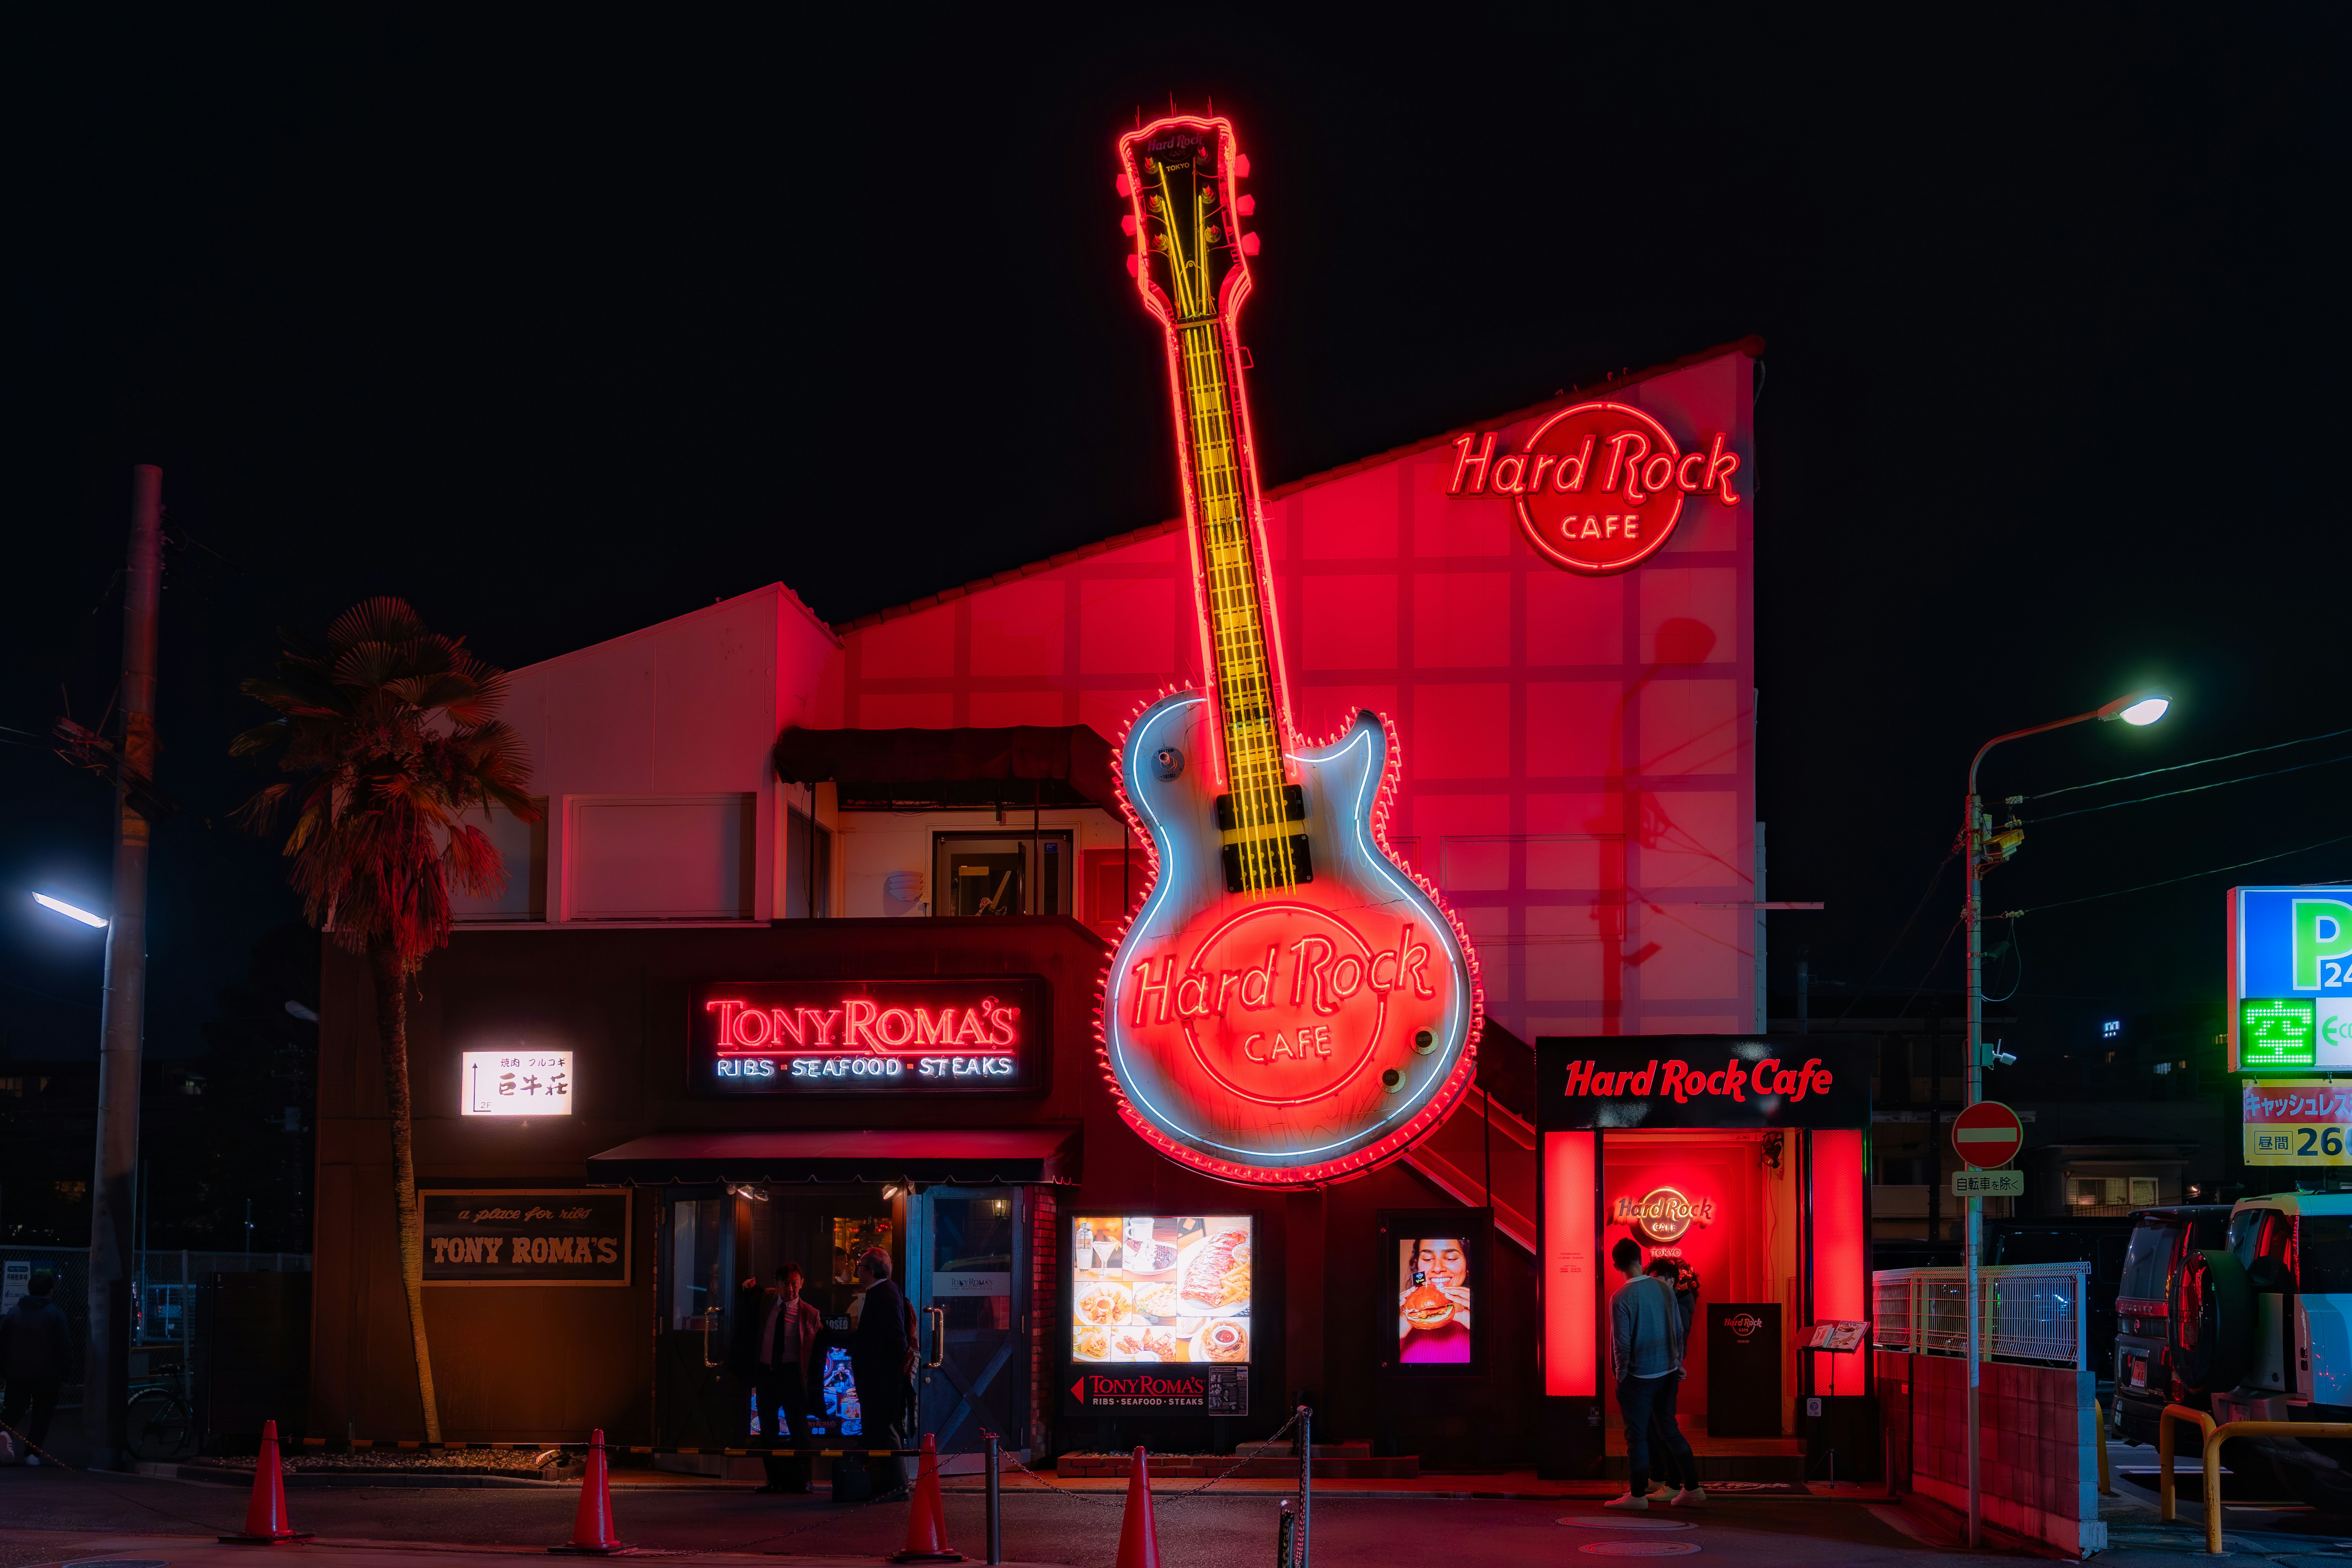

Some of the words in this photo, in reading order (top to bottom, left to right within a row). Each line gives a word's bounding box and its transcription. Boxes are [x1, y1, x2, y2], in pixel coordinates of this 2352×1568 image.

[1147, 136, 1175, 152] Hard
[1176, 133, 1204, 149] Rock
[1166, 162, 1190, 172] TOKYO
[1446, 431, 1597, 495] Hard
[1601, 430, 1740, 506] Rock
[1560, 514, 1640, 541] CAFE
[1131, 944, 1280, 1029] Hard
[1289, 922, 1436, 1016] Rock
[2246, 1001, 2312, 1064] 空
[1243, 1024, 1333, 1064] CAFE
[501, 1058, 520, 1067] 焼肉
[717, 1058, 775, 1077] RIBS
[791, 1058, 903, 1077] SEAFOOD
[919, 1057, 1013, 1078] STEAKS
[1564, 1060, 1658, 1096] Hard
[1660, 1059, 1748, 1104] Rock
[1751, 1058, 1833, 1102] Cafe
[2245, 1093, 2352, 1117] キャッシュレス
[2259, 1136, 2288, 1151] 昼間
[1956, 1176, 2019, 1191] 自転車を除く
[458, 1209, 470, 1219] a
[472, 1207, 521, 1223] place
[524, 1207, 554, 1221] for
[559, 1207, 592, 1220] ribs
[1619, 1197, 1665, 1218] Hard
[1666, 1197, 1712, 1222] Rock
[1652, 1222, 1676, 1232] CAFE
[432, 1237, 503, 1263] TONY
[512, 1237, 618, 1263] ROMA'S
[1724, 1318, 1744, 1326] Hard
[1744, 1318, 1762, 1328] Rock
